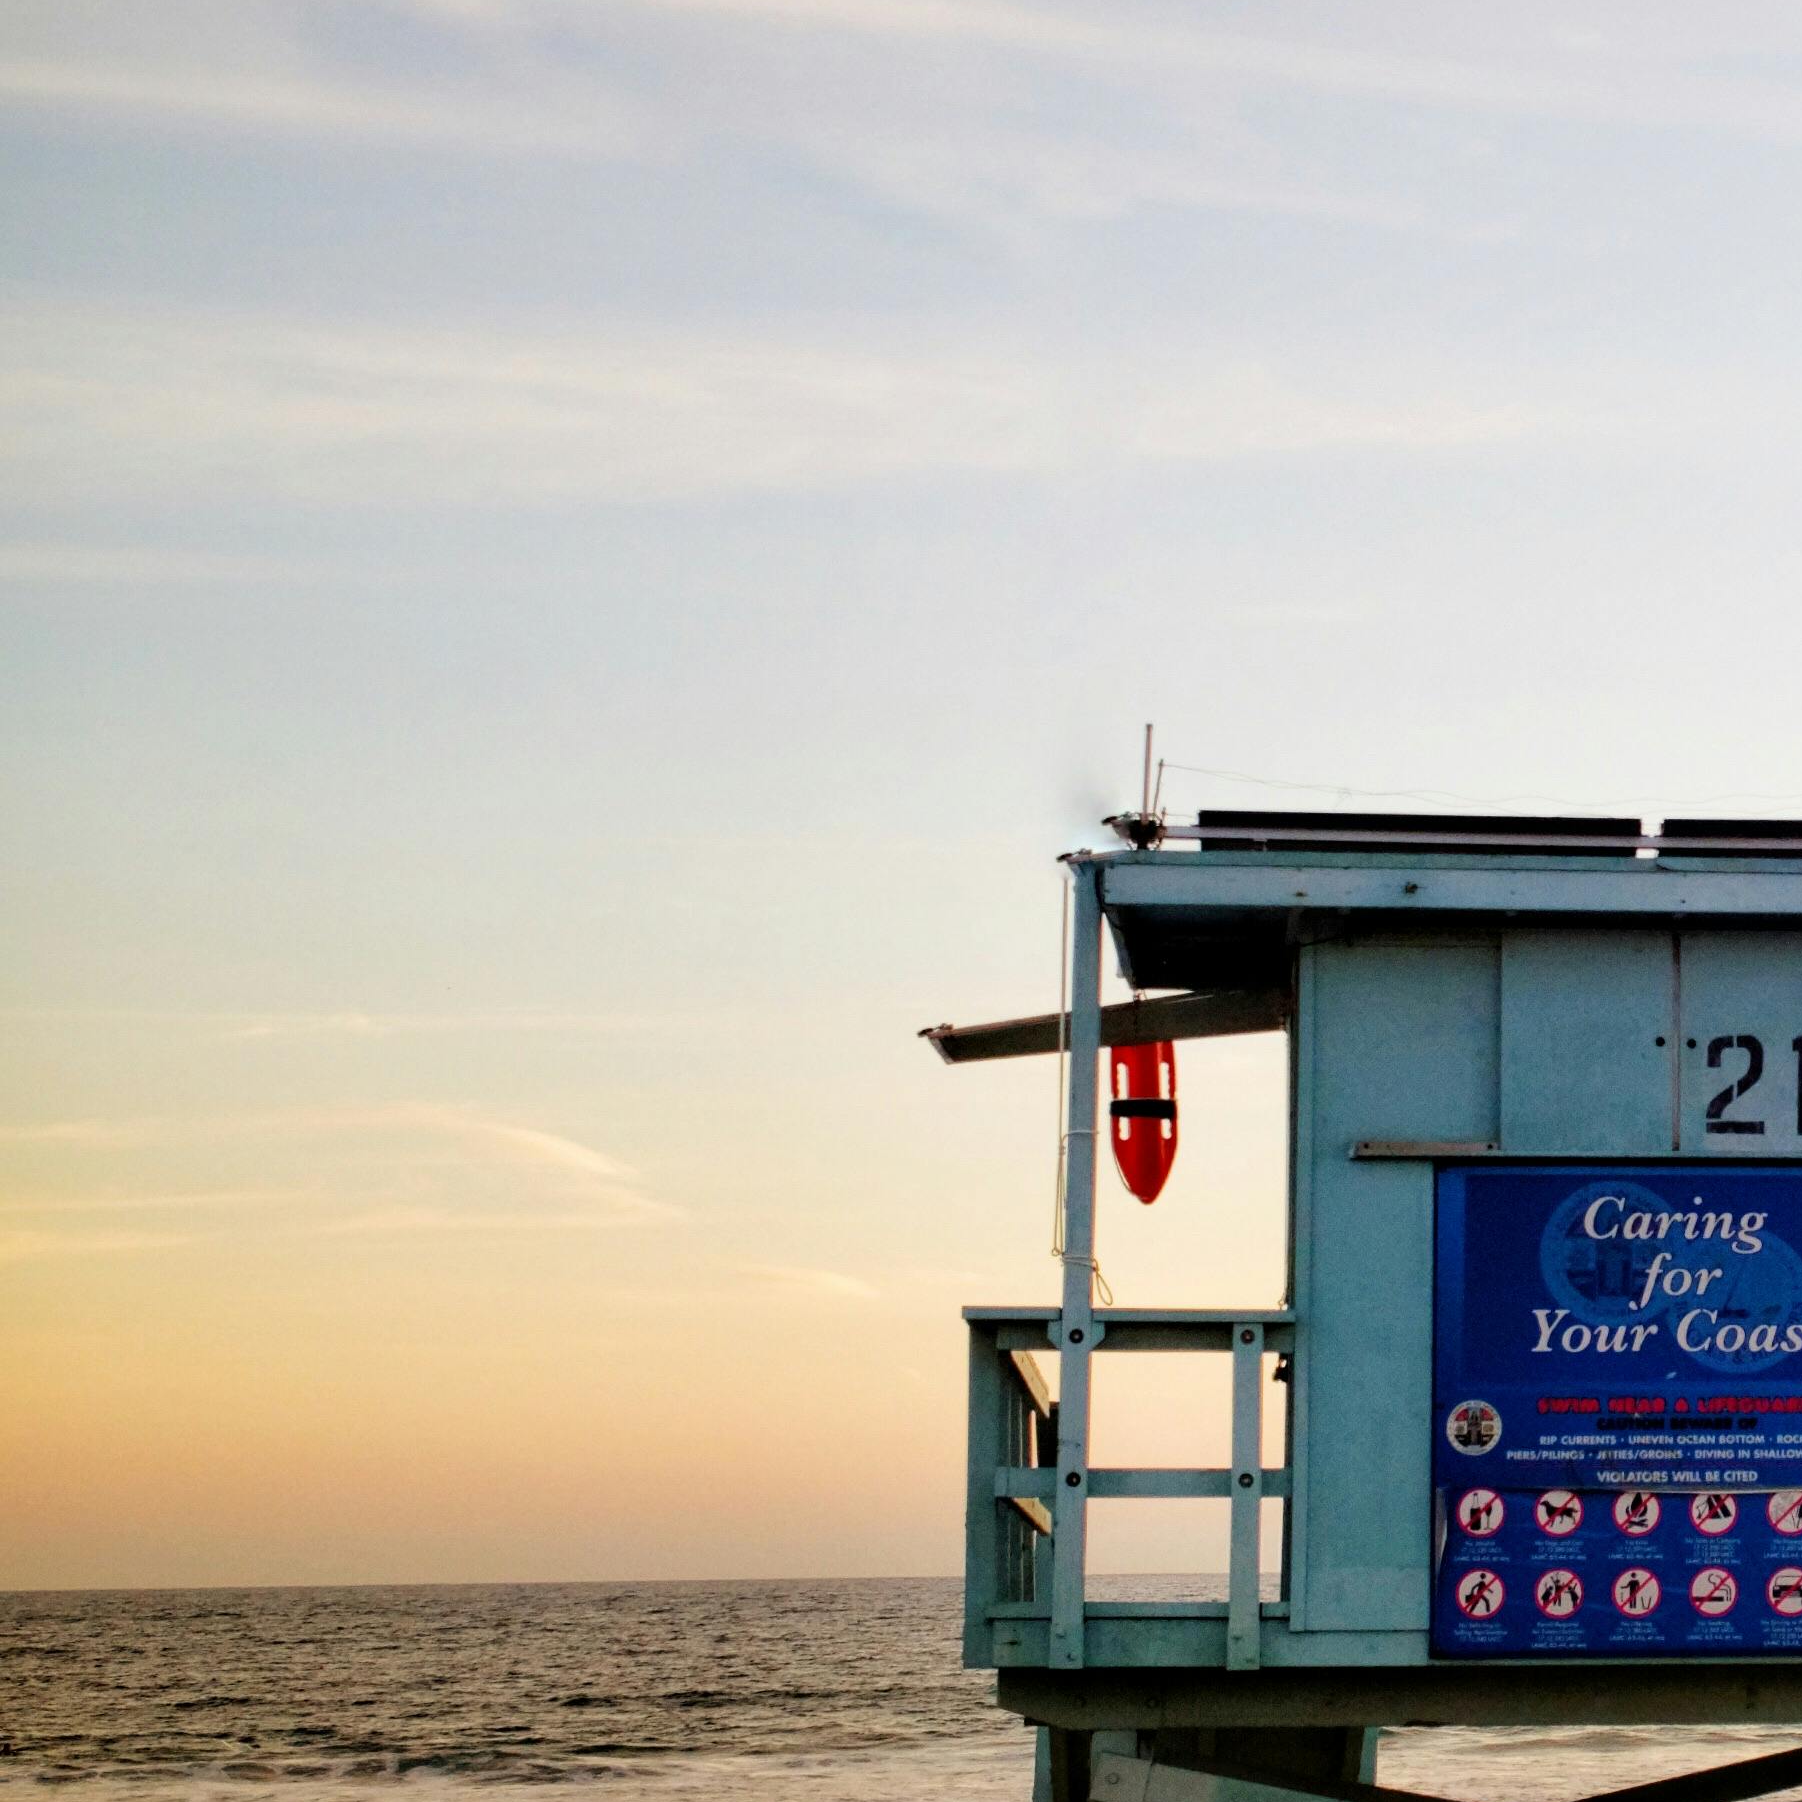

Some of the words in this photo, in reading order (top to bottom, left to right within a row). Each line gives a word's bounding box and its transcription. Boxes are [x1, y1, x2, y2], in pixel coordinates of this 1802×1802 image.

[1583, 1196, 1768, 1254] Caring
[1628, 1253, 1723, 1311] for
[1531, 1308, 1659, 1353] Your
[1536, 1397, 1601, 1414] SWIM
[1673, 1397, 1690, 1414] A
[1597, 1418, 1665, 1431] CAUTION
[1539, 1435, 1558, 1446] RIP
[1560, 1435, 1617, 1446] CURRENTS
[1628, 1435, 1674, 1445] UNEVEN
[1676, 1434, 1716, 1444] OCEAN
[1718, 1434, 1766, 1444] BOTTOM
[1506, 1450, 1585, 1460] PIERS/PILINGS
[1597, 1450, 1684, 1460] JETTIES/GROINS
[1694, 1449, 1735, 1459] DIVING
[1738, 1449, 1751, 1459] IN
[1596, 1471, 1669, 1483] VIOLATORS
[1672, 1471, 1703, 1482] WILL
[1705, 1471, 1721, 1482] BE
[1723, 1471, 1759, 1482] CITED
